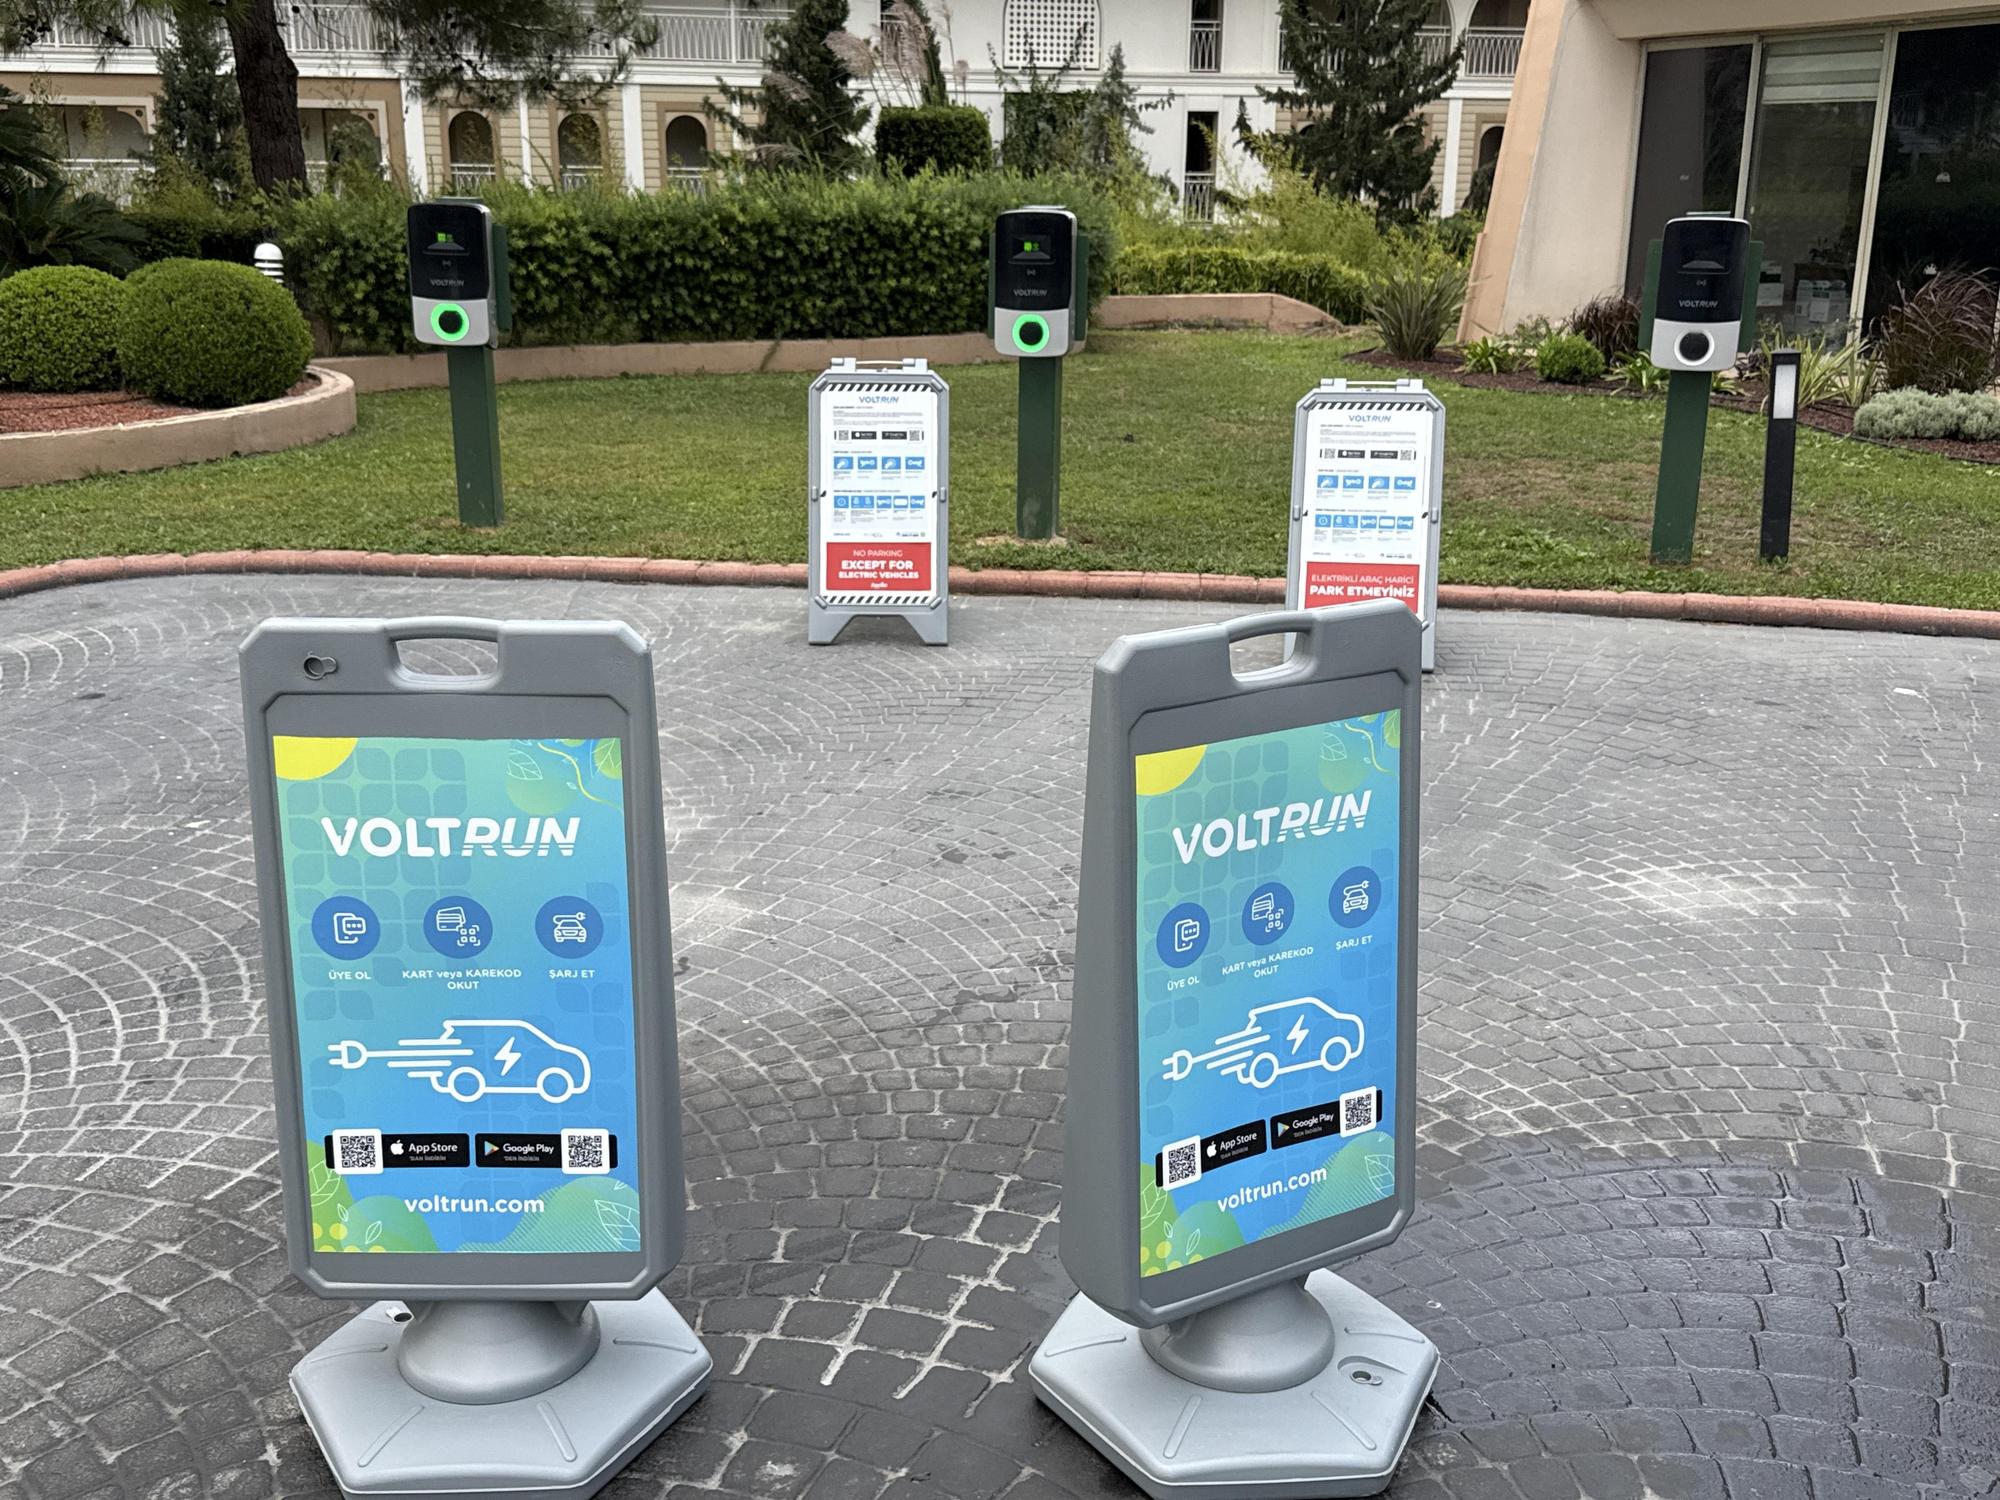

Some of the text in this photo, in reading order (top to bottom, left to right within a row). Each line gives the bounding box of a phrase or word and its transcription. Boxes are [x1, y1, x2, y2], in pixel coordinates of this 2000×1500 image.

[1013, 289, 1048, 297] VOLTRUN
[1678, 300, 1718, 308] VOLTRUN
[859, 396, 899, 404] VOLTRUN
[1348, 415, 1392, 423] VOLTRUN
[853, 549, 903, 557] NO PARKING
[841, 560, 913, 570] EXCEPT FOR
[838, 571, 919, 579] ELECTRIC VEHICLES
[1311, 573, 1414, 585] ELEKTRİKLİ ARAÇ HARİCİ
[1309, 584, 1415, 598] PARK ETMEYİNİZ
[1171, 789, 1372, 865] VOLTRUN
[320, 817, 581, 858] VOLTRUN
[1335, 935, 1373, 951] ŞARJ ET
[1222, 946, 1314, 975] KART veya KAREKOD
[328, 969, 372, 980] ÜYE OL
[402, 968, 522, 980] KART veya KAREKOD
[549, 969, 595, 980] ŞARJ ET
[1254, 965, 1280, 978] OKUT
[447, 981, 480, 990] OKUT
[1167, 976, 1200, 991] ÜYE OL
[1292, 1112, 1334, 1129] Google Play
[1220, 1132, 1257, 1151] App Store
[408, 1142, 458, 1154] App Store
[502, 1142, 554, 1155] Google Play
[1217, 1166, 1327, 1212] voltrun.com
[404, 1194, 545, 1213] voltrun.com
